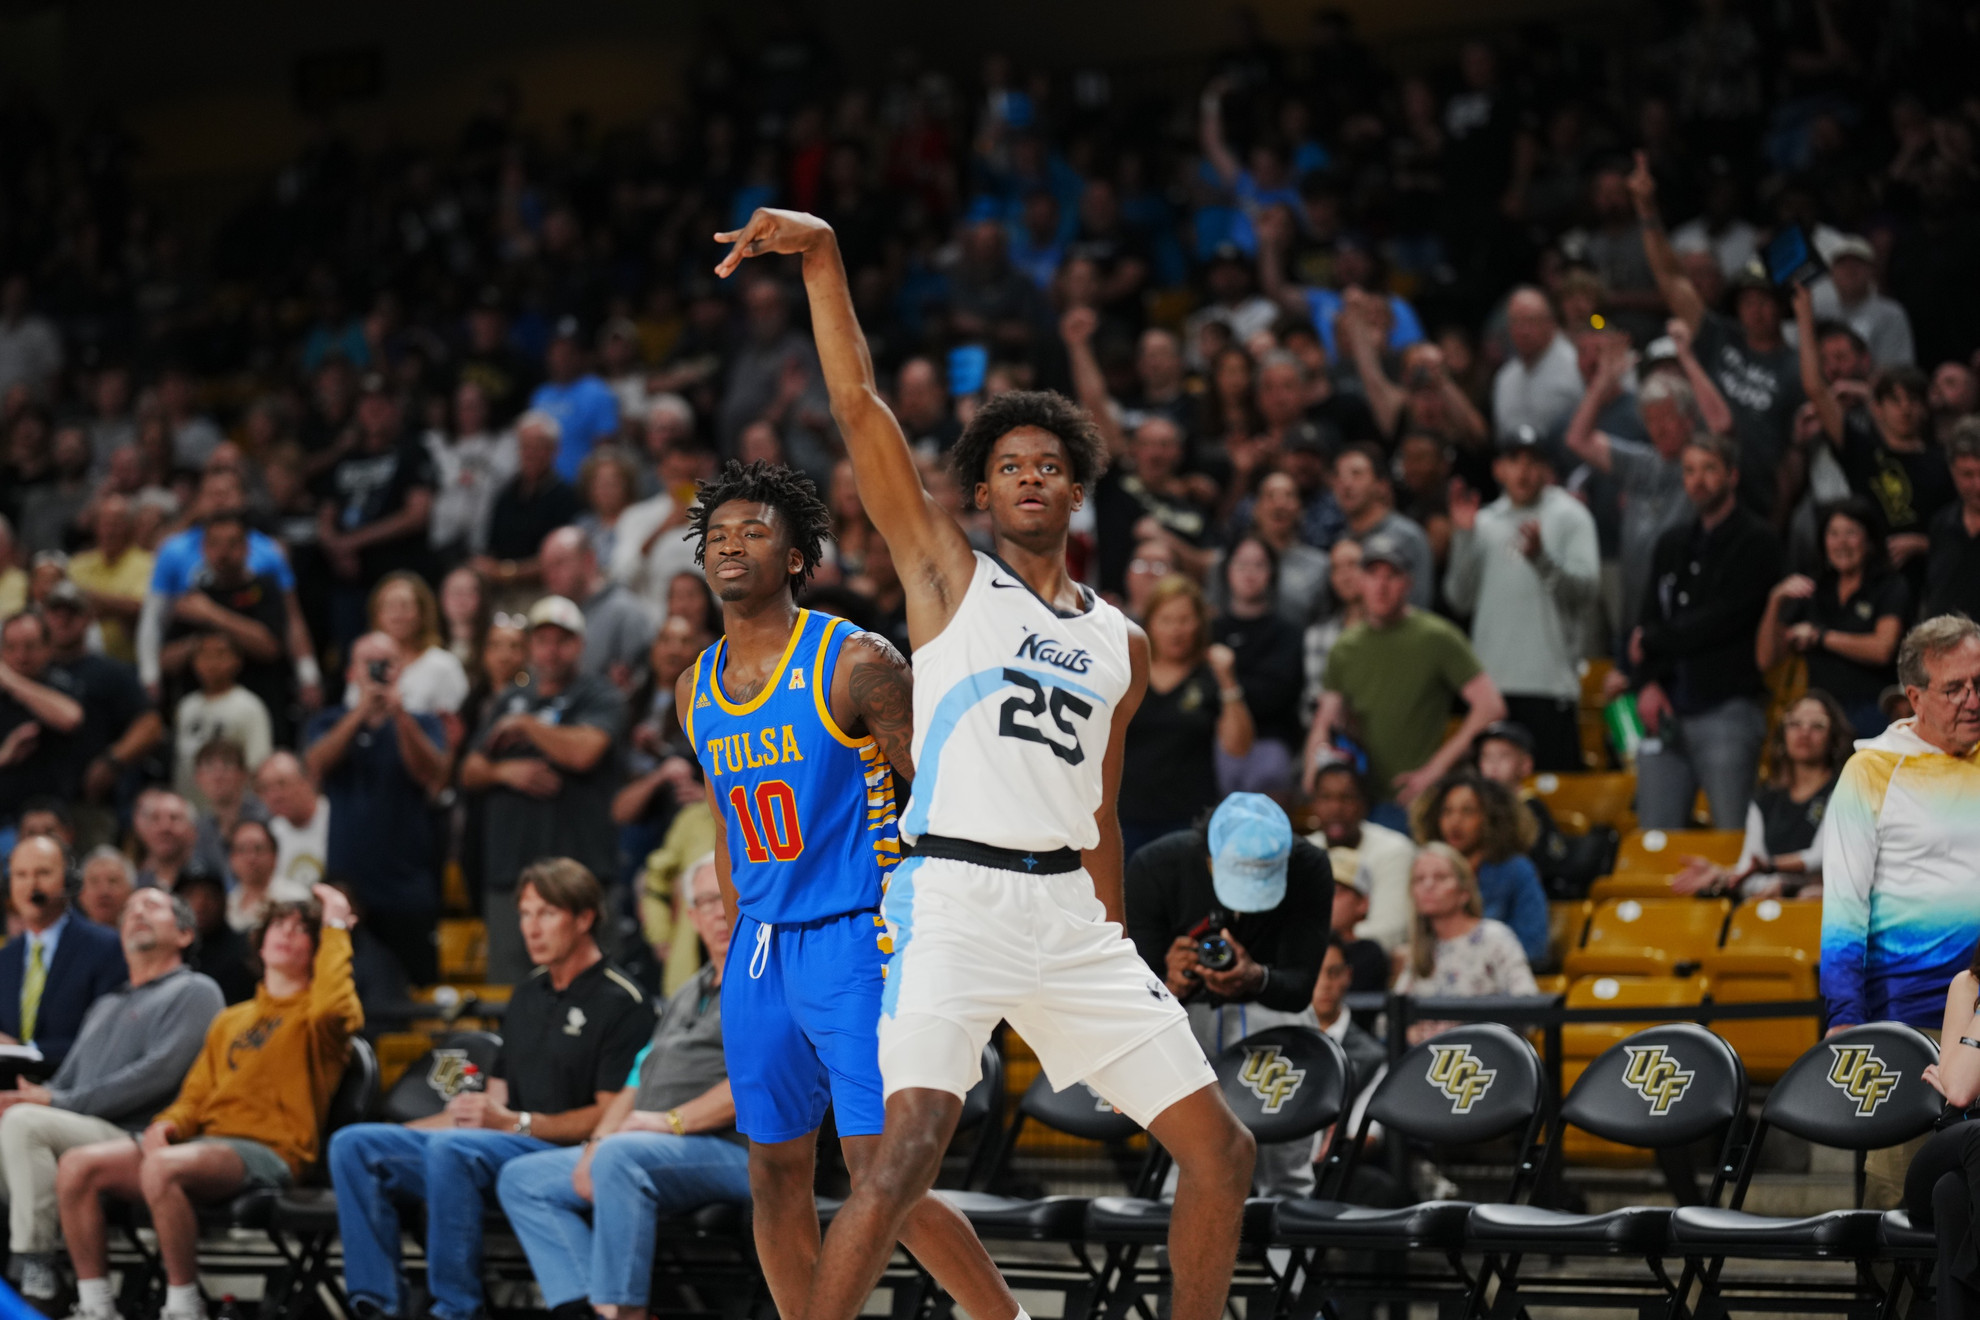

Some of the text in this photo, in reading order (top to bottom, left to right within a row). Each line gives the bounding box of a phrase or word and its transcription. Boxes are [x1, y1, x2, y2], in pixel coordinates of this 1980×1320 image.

[1014, 633, 1093, 674] Nauts
[707, 725, 804, 776] TULSA
[999, 667, 1093, 766] 25
[729, 780, 804, 863] 10
[1237, 1045, 1306, 1114] UCF
[1426, 1044, 1497, 1114] UCF
[1621, 1045, 1695, 1116] UCF
[1827, 1044, 1902, 1117] UCF
